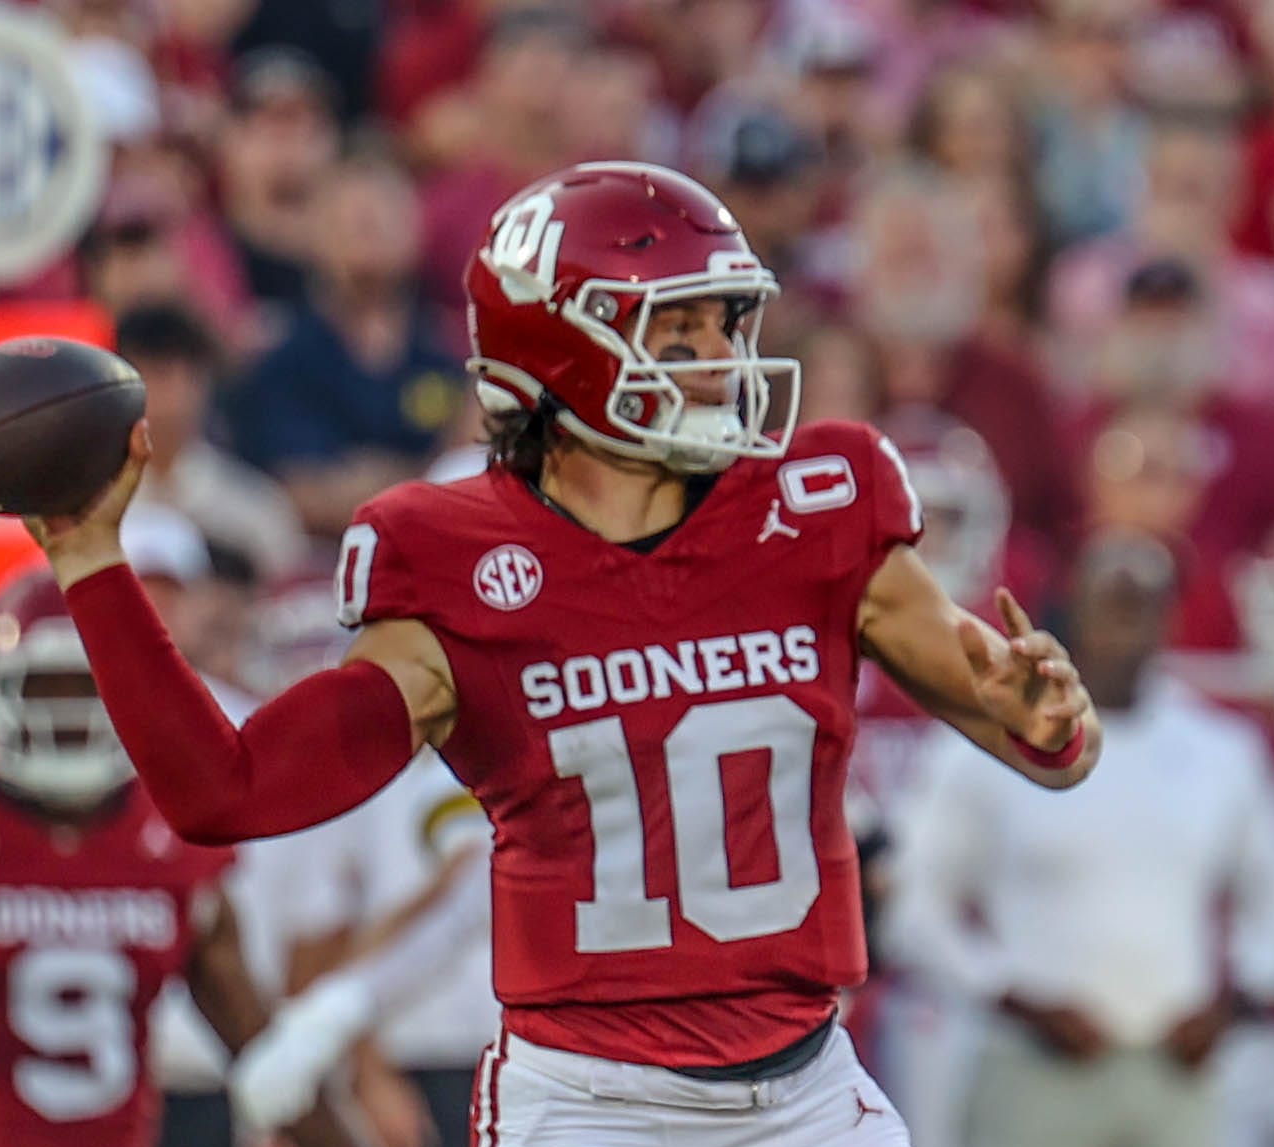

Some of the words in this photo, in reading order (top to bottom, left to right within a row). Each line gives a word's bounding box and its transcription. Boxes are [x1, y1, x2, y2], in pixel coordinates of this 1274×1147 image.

[477, 550, 540, 606] SEC
[520, 624, 822, 720] SOONERS
[547, 693, 822, 955] 10
[6, 946, 140, 1123] 9
